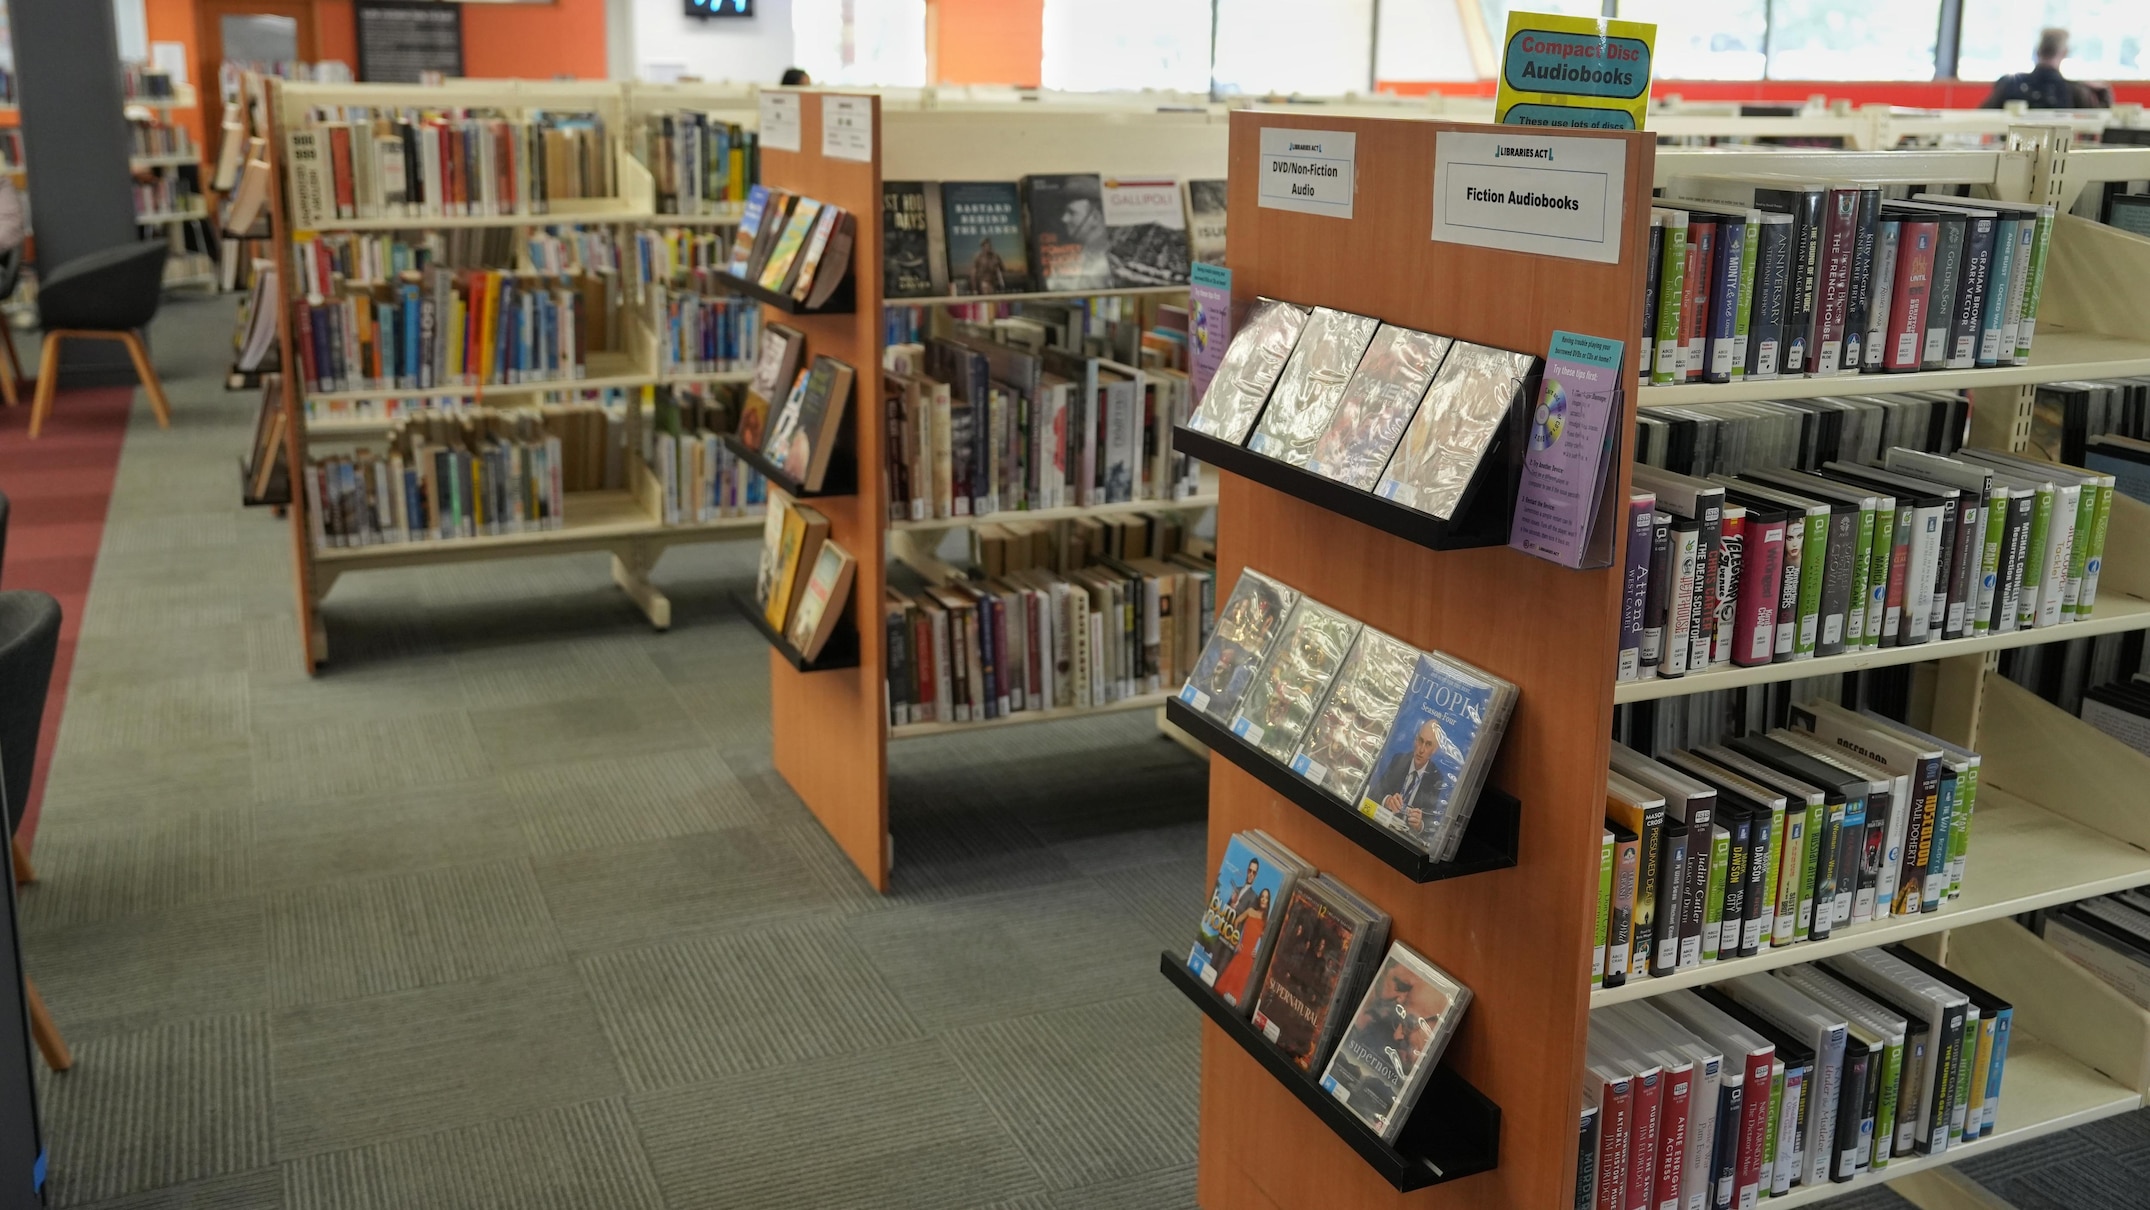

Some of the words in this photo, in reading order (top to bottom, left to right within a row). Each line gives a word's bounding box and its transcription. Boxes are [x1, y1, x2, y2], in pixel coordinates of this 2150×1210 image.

[1522, 36, 1602, 59] Compact
[1607, 43, 1640, 61] Disc
[1522, 61, 1633, 86] Audiobooks
[1520, 116, 1548, 126] These
[1571, 119, 1588, 128] lots
[1591, 120, 1600, 128] of
[1602, 122, 1624, 130] discs
[1500, 147, 1533, 158] LIBRARIES
[1535, 149, 1548, 159] ACT
[1273, 161, 1338, 177] DVD/Non-Fiction
[1110, 194, 1172, 206] GALLIPOLI
[1292, 183, 1315, 196] Audio
[1467, 187, 1504, 203] Fiction
[1508, 190, 1579, 211] Audiobooks
[894, 213, 926, 230] DAYS
[955, 203, 1012, 213] BASTARD
[960, 214, 1008, 224] BEHIND
[953, 225, 977, 234] THE
[981, 224, 1018, 234] LINES
[1810, 226, 1818, 239] THE
[1798, 224, 1808, 262] NATHAN
[1808, 241, 1816, 265] SOUND
[1832, 233, 1841, 254] THE
[1853, 226, 1865, 281] ANNEMARIE
[1862, 233, 1874, 256] Kitty
[2005, 232, 2013, 254] ANNE
[1727, 257, 1739, 288] MONTY
[1764, 246, 1772, 286] STEPHANIE
[1807, 266, 1814, 276] OF
[1827, 258, 1838, 300] FRENCH
[1942, 251, 1954, 291] GOLDEN
[1968, 258, 1978, 284] DARK
[1975, 250, 1987, 293] GRAHAM
[2001, 256, 2009, 276] BUIST
[1664, 280, 1674, 295] John
[1726, 289, 1735, 298] &
[1771, 234, 1787, 326] ANNIVERSARY
[1793, 264, 1804, 316] BLACKWELL
[1805, 277, 1814, 291] HER
[1859, 259, 1872, 305] McKenzie
[1725, 300, 1733, 316] me
[1803, 292, 1812, 312] VOICE
[1850, 284, 1859, 313] BREAR
[1940, 294, 1950, 314] SON
[1961, 287, 1974, 326] VECTOR
[1662, 297, 1671, 332] Banville
[1822, 304, 1833, 340] HOUSE
[1969, 296, 1981, 332] BROWN
[1554, 348, 1572, 356] borrowed
[1572, 350, 1581, 358] DVDs
[1599, 355, 1612, 363] home?
[1562, 336, 1574, 346] Having
[1575, 338, 1588, 346] trouble
[1588, 340, 1602, 351] playing
[1602, 343, 1611, 351] your
[1562, 366, 1576, 376] these
[1576, 368, 1586, 379] tips
[1586, 370, 1598, 381] first:
[1539, 461, 1551, 471] Another
[2017, 522, 2029, 561] MICHAEL
[2066, 525, 2074, 549] JILLY
[1697, 542, 1707, 560] THE
[1863, 548, 1871, 568] BOY
[1984, 542, 1997, 565] BRAM
[2005, 527, 2020, 581] Resurrection
[2051, 541, 2064, 580] Tackle!
[1694, 563, 1705, 593] DEATH
[1706, 550, 1718, 584] CHRIS
[1718, 554, 1728, 598] Avenue
[1762, 547, 1778, 598] Wronged
[1855, 554, 1864, 578] ELIZA
[2057, 553, 2071, 592] COOPER
[1627, 569, 1635, 594] WEST
[1781, 566, 1795, 609] CHAMBERS
[1852, 579, 1861, 608] CLARK
[1631, 565, 1648, 633] Attend
[1702, 587, 1715, 631] CARTER
[1624, 598, 1633, 631] CAMEL
[1411, 673, 1480, 722] UTOPIA
[1421, 702, 1442, 720] Season
[1442, 712, 1457, 726] Four
[1646, 812, 1664, 821] MASON
[1646, 819, 1663, 827] CROSS
[1912, 798, 1924, 821] PAUL
[1907, 823, 1920, 866] DOHERTY
[1916, 795, 1937, 867] ROSEBLOOD
[1646, 827, 1659, 876] PRESUMED
[1730, 847, 1741, 883] DAWSON
[1740, 853, 1748, 875] MARK
[1752, 846, 1764, 882] DAWSON
[1696, 852, 1708, 886] Judith
[1619, 871, 1627, 899] CRANE
[1626, 870, 1634, 899] TERESA
[1643, 878, 1655, 906] DEAD
[1684, 887, 1692, 896] of
[1210, 889, 1236, 924] burn
[1318, 904, 1326, 918] 12
[1682, 898, 1690, 923] DEATH
[1692, 890, 1704, 924] Cutler
[1726, 893, 1737, 912] CITY
[1735, 889, 1744, 913] KILLA
[1205, 908, 1240, 946] notice
[1618, 921, 1628, 943] Wild
[1269, 977, 1318, 1027] SUPERNATURAL
[1348, 1040, 1399, 1085] supernova
[1944, 1045, 1952, 1062] THE
[1950, 1039, 1960, 1075] ROBERT
[1823, 1065, 1834, 1096] Under
[1939, 1064, 1950, 1099] RUNNING
[1749, 1102, 1757, 1118] The
[1757, 1101, 1765, 1125] NIGEL
[1765, 1100, 1776, 1140] RICHARD
[1797, 1098, 1806, 1125] IDENTITY
[1936, 1100, 1945, 1127] GRAVE
[1605, 1134, 1614, 1150] JIM
[1615, 1111, 1624, 1148] NATURAL
[1639, 1125, 1647, 1140] JIM
[1675, 1117, 1685, 1146] ANNE
[1697, 1123, 1706, 1142] Pam
[1745, 1120, 1755, 1154] Dictator's
[1817, 1110, 1828, 1153] Mistletoe
[1648, 1143, 1654, 1152] AT
[1663, 1138, 1674, 1181] ACTRESS
[1695, 1144, 1703, 1168] Evans
[1752, 1128, 1762, 1172] FARNDALE
[1601, 1154, 1612, 1204] ELDRIDGE
[1611, 1152, 1620, 1184] HISTORY
[1635, 1142, 1646, 1190] ELDRIDGE
[1670, 1151, 1681, 1196] ENRIGHT
[1742, 1156, 1750, 1176] Muse
[1642, 1175, 1650, 1202] SAVOY
